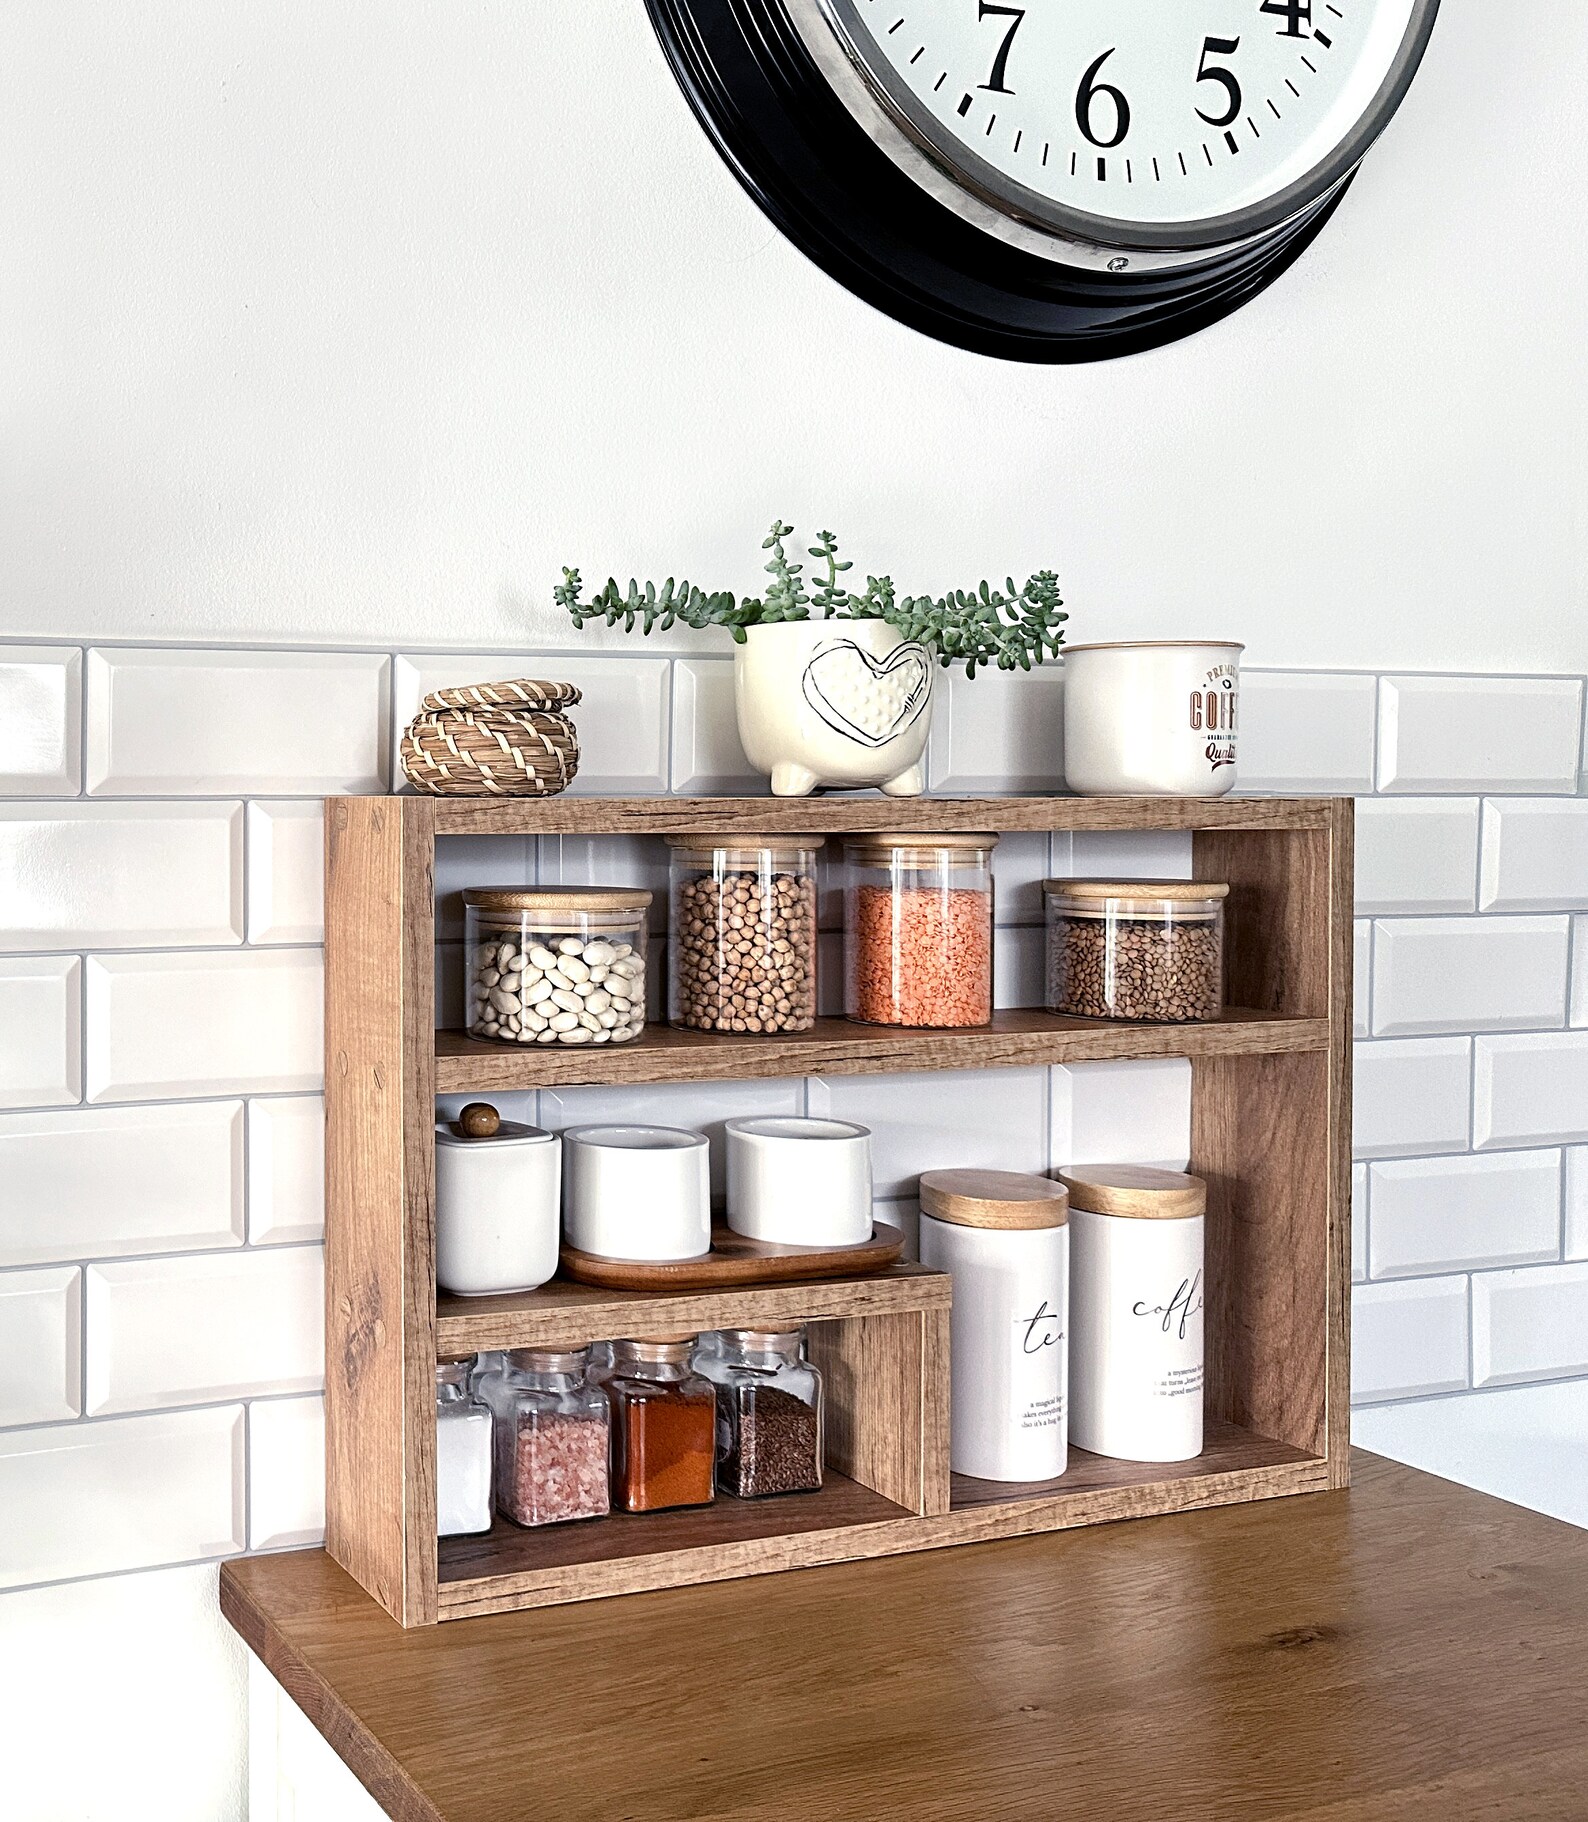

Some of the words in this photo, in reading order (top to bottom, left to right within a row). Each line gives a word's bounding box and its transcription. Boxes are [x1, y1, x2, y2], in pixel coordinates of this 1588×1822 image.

[977, 0, 1025, 95] 7
[1195, 35, 1242, 127] 5
[1075, 47, 1131, 148] 6
